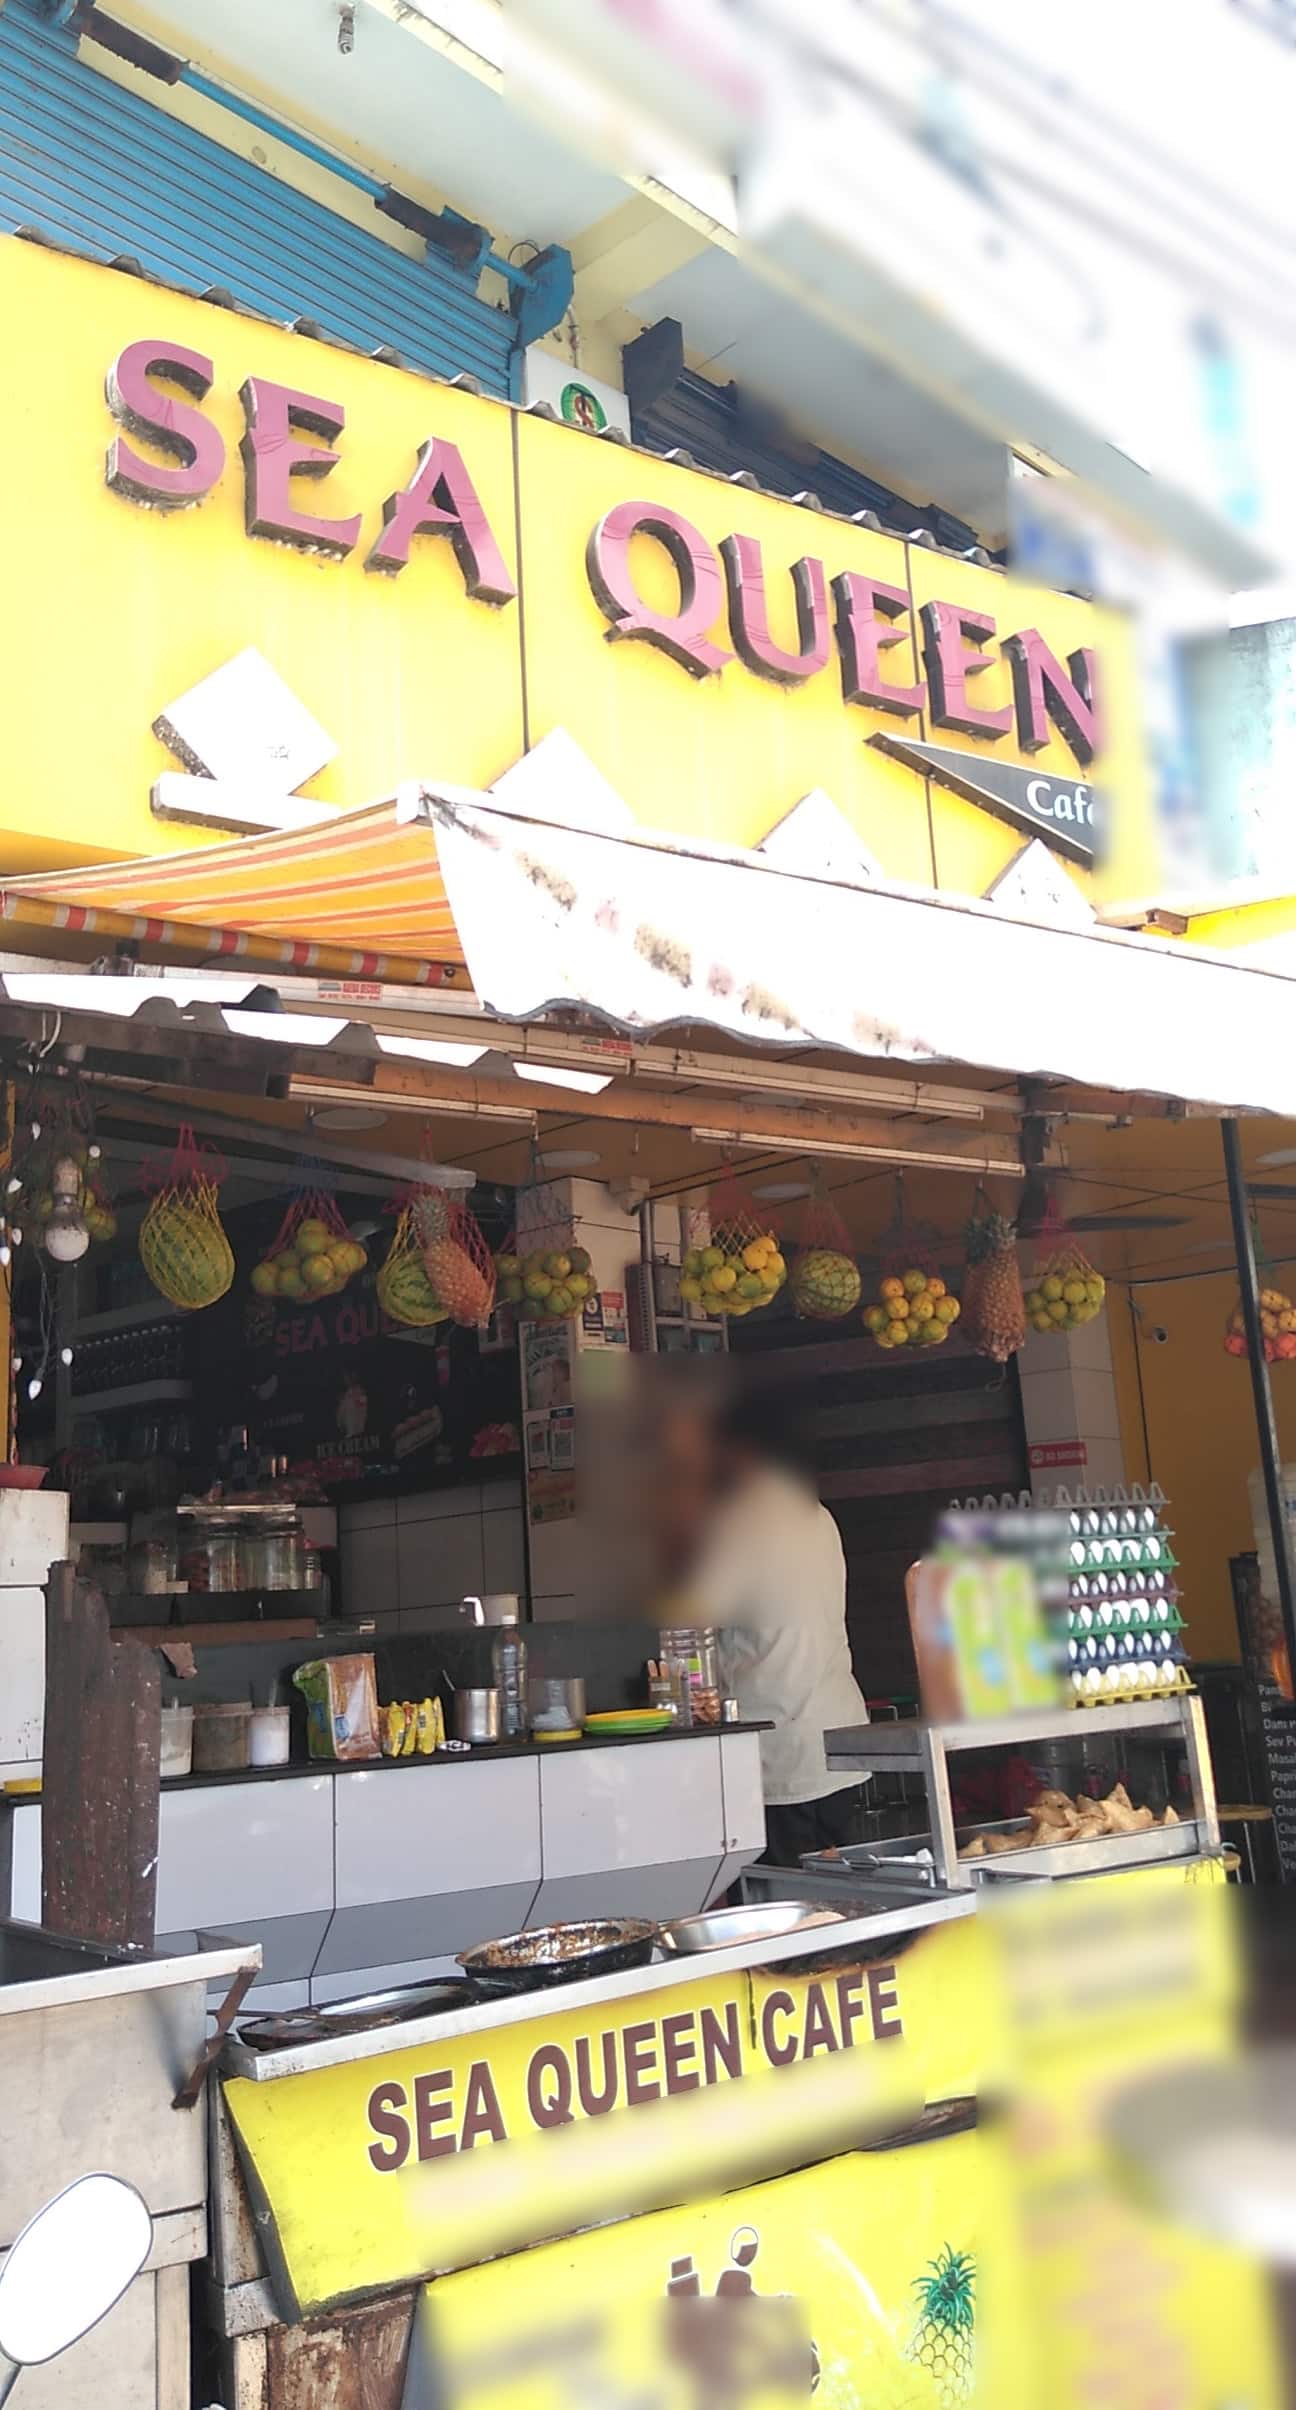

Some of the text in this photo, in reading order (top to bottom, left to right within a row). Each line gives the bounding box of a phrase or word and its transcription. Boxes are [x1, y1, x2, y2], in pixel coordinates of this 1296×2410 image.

[105, 340, 1095, 765] SEA QUEEN
[367, 1964, 902, 2173] SEA QUEEN CAFE
